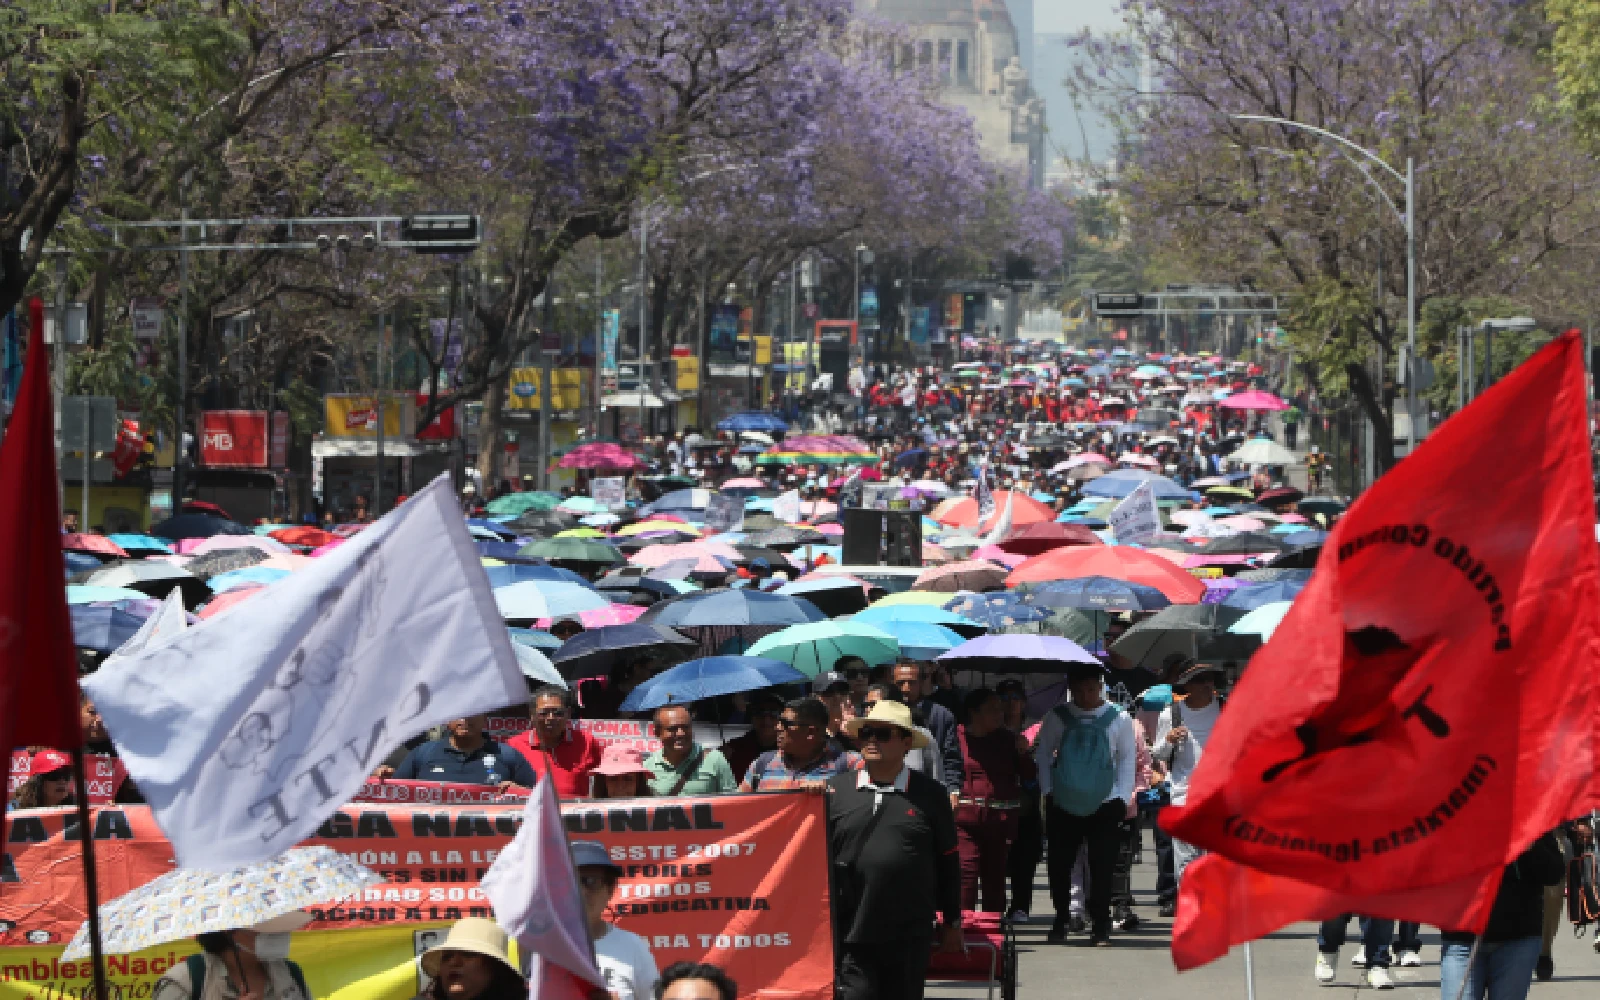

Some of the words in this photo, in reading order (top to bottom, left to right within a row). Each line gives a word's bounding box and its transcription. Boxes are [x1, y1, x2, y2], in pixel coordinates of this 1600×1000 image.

[203, 433, 233, 451] MB
[311, 811, 399, 840] GA
[406, 850, 424, 865] A
[429, 850, 464, 864] LA
[470, 850, 500, 864] LE
[610, 844, 678, 861] SSTE
[687, 842, 757, 859] 2007
[380, 869, 412, 883] ES
[420, 867, 469, 883] SIN
[429, 887, 487, 901] SOC
[618, 881, 712, 899] TODOS
[617, 896, 771, 915] EDUCATIVA
[697, 931, 792, 948] TODOS
[1, 957, 94, 981] mblea
